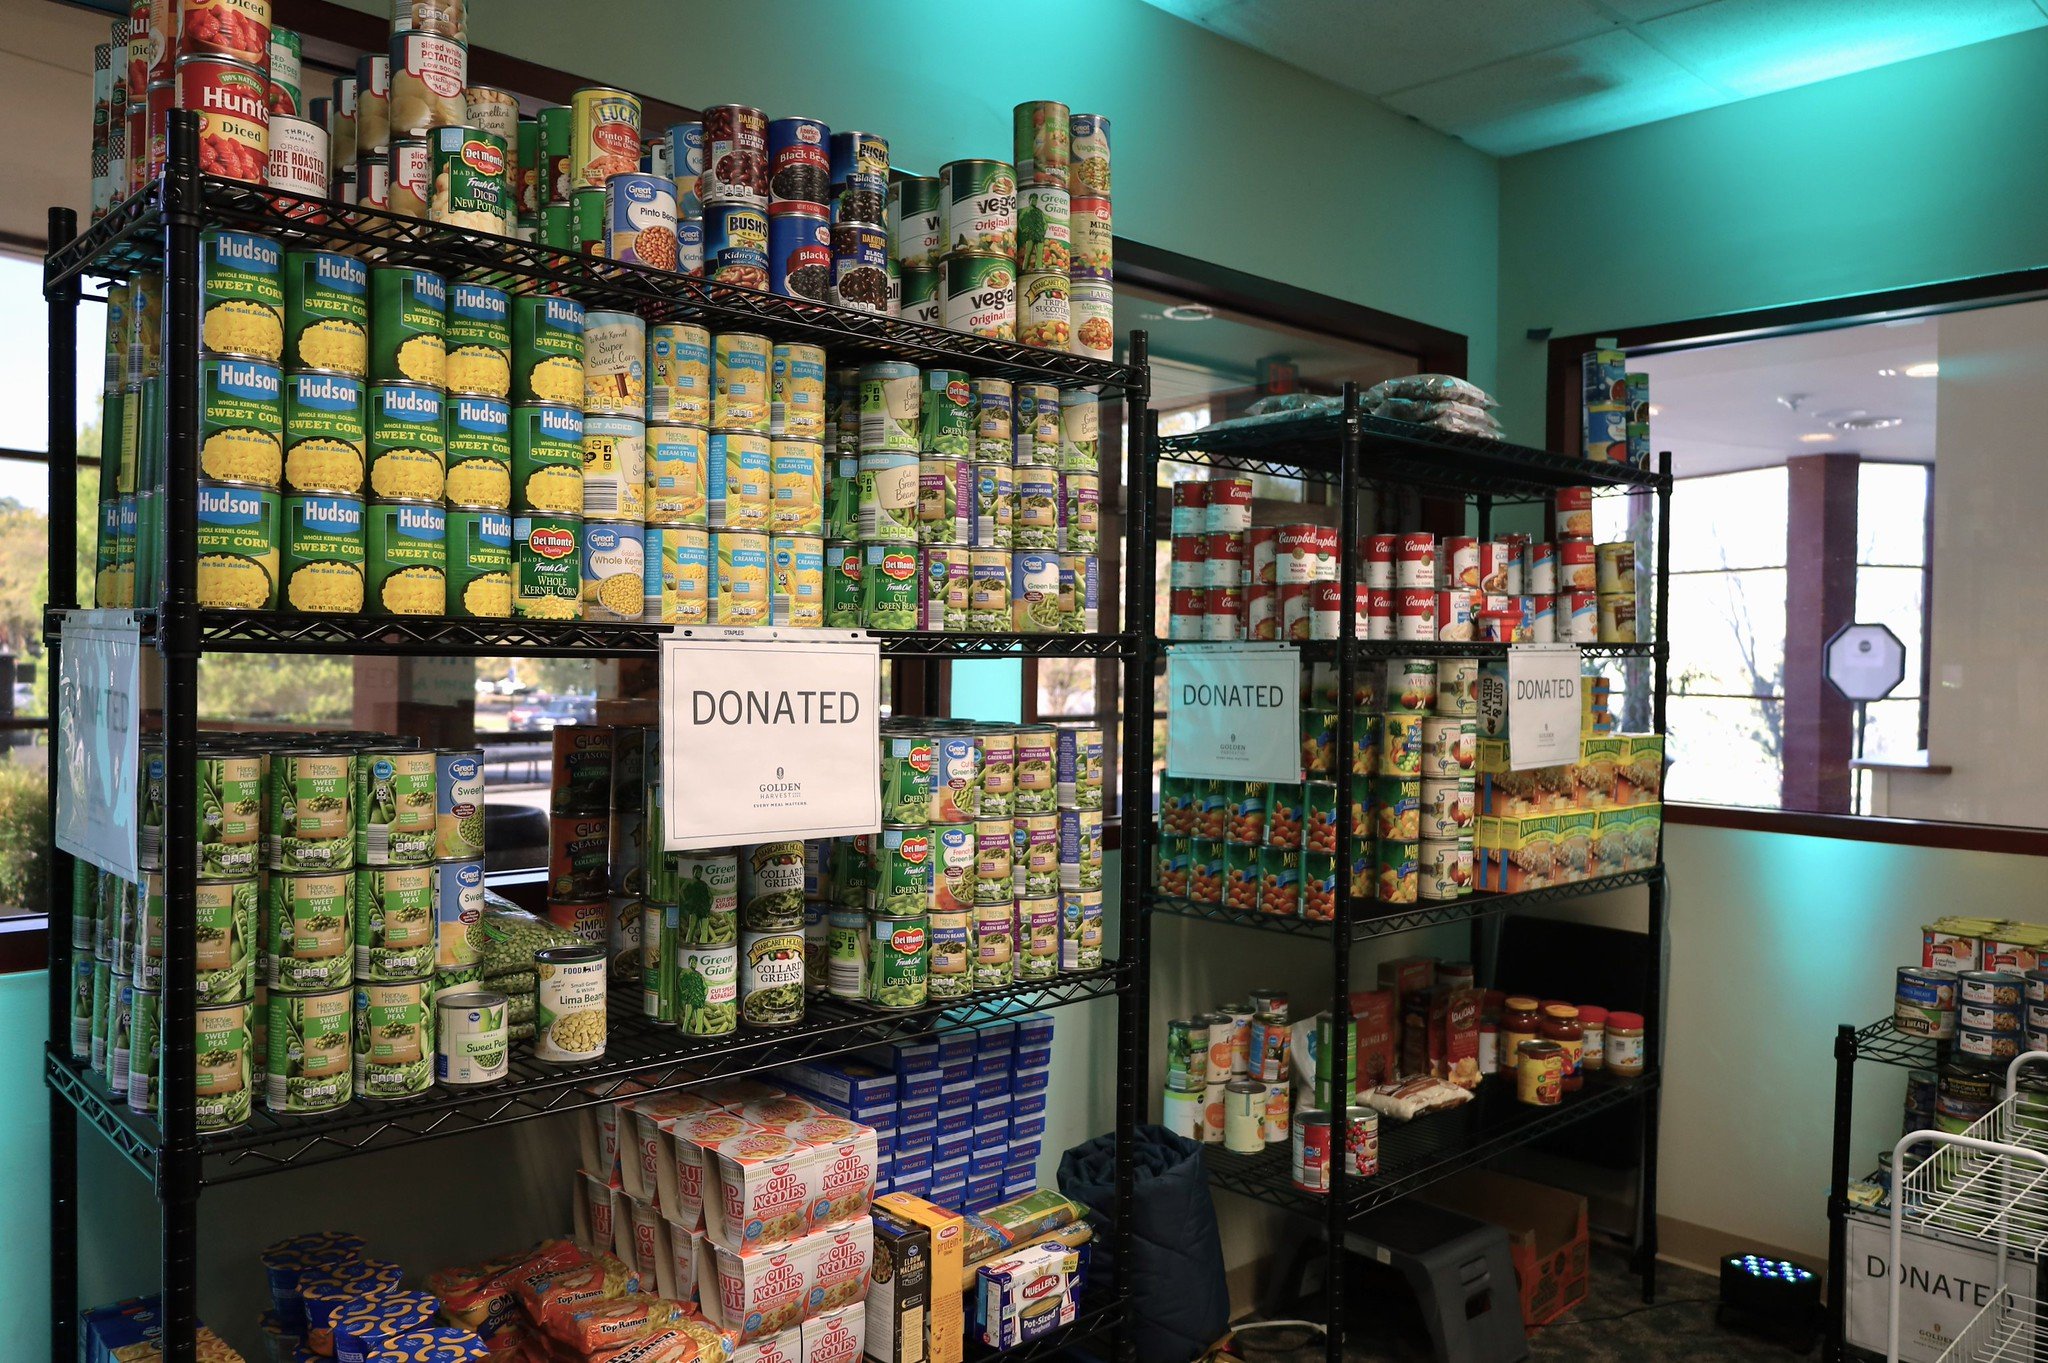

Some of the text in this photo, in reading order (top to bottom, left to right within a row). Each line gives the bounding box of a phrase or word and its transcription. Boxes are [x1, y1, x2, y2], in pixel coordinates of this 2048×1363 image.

[421, 41, 463, 59] sliced white
[421, 50, 462, 69] POTATOES
[423, 61, 438, 71] LOW
[238, 76, 263, 93] NATURAL
[466, 106, 510, 121] Cannellini
[478, 118, 505, 130] Beans
[221, 121, 262, 143] Diced
[285, 128, 316, 141] THRIVE
[598, 130, 622, 143] Pinto
[737, 132, 765, 145] KIDNEY
[280, 142, 318, 157] ORGANIC
[740, 138, 764, 150] BEANS
[269, 149, 325, 174] FIRE ROASTED
[465, 148, 503, 167] Del Monte
[780, 149, 807, 164] Black
[468, 177, 502, 192] Fresh Cut
[628, 185, 652, 196] Great
[474, 188, 498, 204] DICED
[634, 191, 652, 200] Value
[1040, 192, 1069, 206] Green
[454, 196, 475, 209] NEW
[1044, 202, 1069, 216] Giant
[640, 207, 661, 219] Pinto
[975, 218, 1010, 231] Original
[219, 236, 278, 266] Hudson
[724, 251, 753, 263] Kidney
[865, 249, 884, 259] BLACK
[864, 255, 885, 266] BEANS
[216, 271, 238, 280] WHOLE
[318, 257, 367, 286] Hudson
[206, 280, 254, 293] SWEET
[456, 289, 506, 314] Hudson
[1044, 299, 1067, 307] TRIPLE
[969, 312, 1006, 327] Original
[598, 341, 624, 354] Super
[590, 351, 637, 368] Sweet Corn
[220, 364, 279, 393] Hudson
[300, 377, 356, 403] Hudson
[385, 391, 438, 414] Hudson
[460, 403, 508, 426] Hudson
[288, 419, 363, 435] SWEET CORN
[604, 422, 634, 431] ADDED
[375, 430, 444, 444] SWEET CORN
[658, 449, 697, 458] CREAM STYLE
[777, 462, 812, 471] CREAM STYLE
[898, 479, 917, 491] Green
[896, 489, 917, 501] Beans
[199, 491, 260, 515] Hudson
[305, 500, 360, 525] Hudson
[400, 508, 445, 531] Hudson
[233, 537, 269, 549] CORN
[532, 535, 573, 547] Del Monte
[590, 534, 615, 543] Great
[596, 540, 616, 548] Value
[533, 562, 569, 573] Fresh Cut
[595, 556, 623, 566] Whole
[1024, 559, 1043, 568] Great
[537, 575, 568, 586] WHOLE
[974, 569, 1006, 579] GREEN BEANS
[523, 584, 578, 596] KERNEL CORN
[1027, 581, 1044, 590] Green
[893, 594, 908, 602] CUT
[878, 600, 898, 611] GREEN
[1493, 680, 1504, 706] SOFT
[1517, 678, 1574, 701] DONATED
[1183, 684, 1284, 709] DONATED
[1482, 677, 1494, 717] CHEWY
[693, 690, 860, 725] DONATED
[1220, 743, 1246, 752] GOLDEN
[452, 763, 475, 773] Great
[312, 778, 337, 787] SWEET
[315, 785, 334, 793] PEAS
[759, 782, 801, 793] GOLDEN
[760, 869, 805, 880] COLLARD
[764, 877, 803, 889] GREENS
[755, 939, 785, 952] MARGARET
[700, 953, 734, 966] Green
[563, 967, 583, 975] FOOD
[704, 964, 734, 976] Giant
[756, 963, 802, 975] COLLARD
[903, 969, 916, 977] CUT
[760, 972, 801, 984] GREENS
[887, 976, 909, 986] GREEN
[560, 991, 605, 1006] Lima Beans
[204, 1031, 231, 1041] SWEET
[208, 1038, 228, 1047] PEAS
[466, 1041, 493, 1053] Sweet
[906, 1135, 932, 1146] SPAGHETTI
[834, 1155, 862, 1174] CUP
[978, 1160, 1004, 1170] SPAGHETTI
[766, 1173, 798, 1192] CUP
[822, 1164, 871, 1190] NOODLES
[752, 1184, 806, 1210] NOODLES
[760, 1203, 788, 1217] CHICKEN
[828, 1243, 857, 1262] CUP
[817, 1252, 866, 1279] NOODLES
[904, 1254, 922, 1267] ELBOW
[899, 1260, 927, 1276] MACARONI
[1024, 1277, 1059, 1298] MUELLER'S
[601, 1316, 648, 1333] Top Ramen
[1023, 1308, 1057, 1329] Pot-Sized
